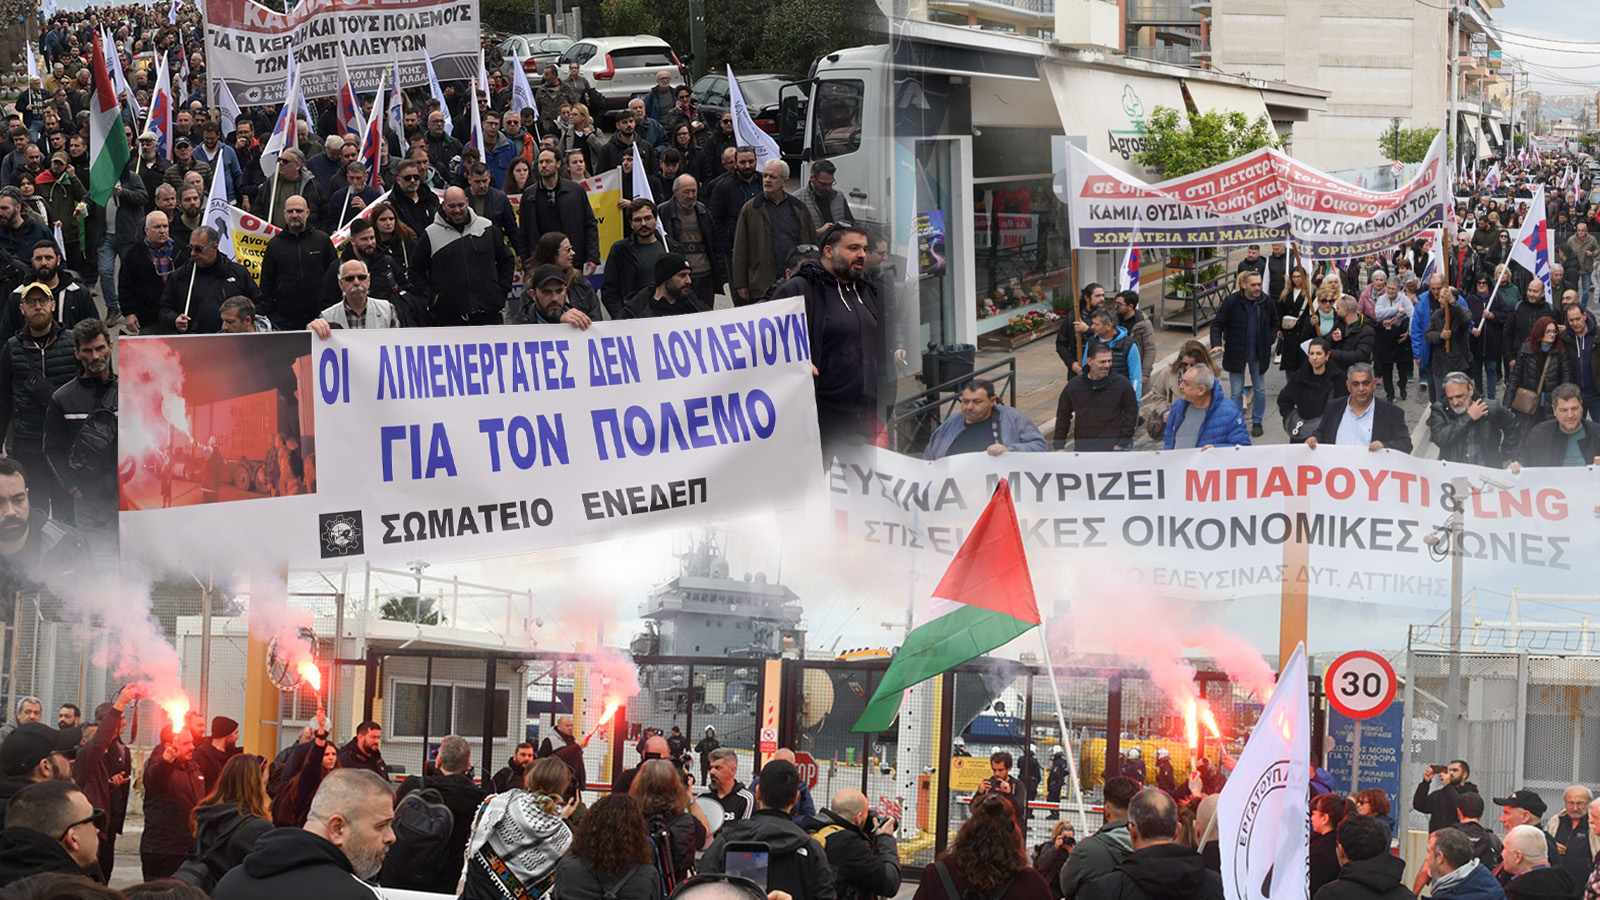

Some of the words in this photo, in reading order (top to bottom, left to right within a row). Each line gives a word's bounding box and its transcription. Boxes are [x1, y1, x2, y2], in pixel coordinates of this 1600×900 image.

[235, 35, 256, 54] ΤΑ
[259, 26, 309, 53] ΚΕΡΔΗ
[309, 17, 336, 38] ΚΑΙ
[338, 15, 380, 34] ΤΟΥΣ
[383, 4, 472, 32] ΠΟΛΕΜΟΥΣ
[255, 54, 288, 74] ΤΩΝ
[381, 65, 422, 78] ΑΤΙΚΗΣ
[1092, 181, 1115, 195] σε
[1185, 180, 1216, 198] στη
[1293, 170, 1321, 184] του
[1282, 185, 1318, 212] δική
[1089, 203, 1143, 221] ΚΑΜΙΑ
[1145, 203, 1193, 222] ΘΥΣΙΑ
[1293, 214, 1331, 236] ΤΟΥΣ
[1332, 205, 1410, 236] ΠΟΛΕΜΟΥΣ
[1409, 184, 1438, 213] ΤΟΥΣ
[1093, 231, 1183, 244] ΣΩΜΑΤΕΙΑ
[1186, 231, 1215, 243] ΚΑΙ
[1317, 236, 1392, 256] ΘΡΙΑΣΙΟΥ
[1393, 208, 1437, 242] ΠΕΔΙΟΥ
[319, 347, 351, 405] ΟΙ
[376, 339, 576, 400] ΛΙΜΕΝΕΡΓΑΤΕΣ
[587, 335, 642, 388] ΔΕΝ
[652, 312, 811, 381] ΔΟΥΛΕΥΟΥΝ
[380, 422, 459, 482] ΓΙΑ
[478, 412, 571, 473] ΤΟΝ
[590, 388, 777, 461] ΠΟΛΕΜΟ
[380, 497, 554, 545] ΣΩΜΑΤΕΙΟ
[581, 476, 708, 521] ΕΝΕΔΕΠ
[985, 469, 1166, 504] ΜΥΡΙΖΕΙ
[1184, 465, 1431, 508] ΜΠΑΡΟΥΤΙ
[1440, 482, 1465, 514] &
[1471, 487, 1570, 522] LNG
[864, 519, 925, 549] ΣΤΙΣ
[927, 516, 1108, 556] ΕΙΚΕΣ
[1121, 512, 1420, 554] ΟΙΚΟΝΟΜΙΚΕΣ
[1431, 525, 1572, 571] ΖΩΝΕΣ
[1152, 564, 1290, 590] ΕΛΕΥΣΙΝΑΣ
[1295, 564, 1341, 588] ΔΥΤ.
[1347, 570, 1448, 598] ΑΤΤΙΚΗΣ
[1340, 671, 1382, 698] 30
[1368, 746, 1396, 756] ΜΟΝΟ
[1341, 775, 1382, 784] AUORITY
